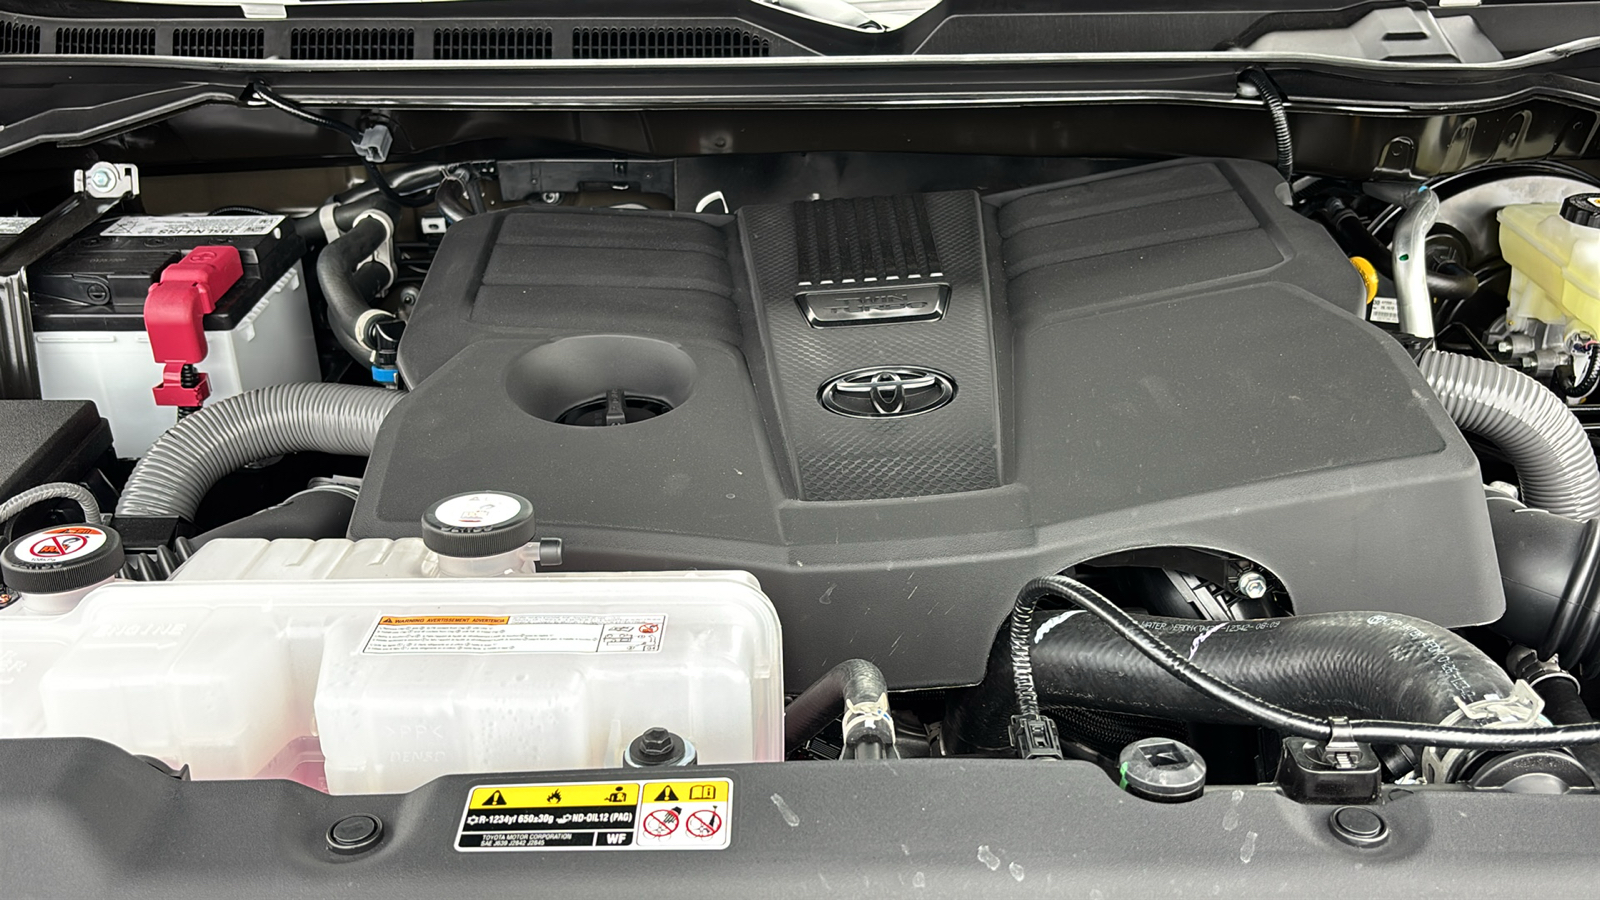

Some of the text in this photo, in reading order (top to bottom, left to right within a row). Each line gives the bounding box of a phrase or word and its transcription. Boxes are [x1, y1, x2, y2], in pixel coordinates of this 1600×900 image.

[390, 751, 446, 762] DENSO
[610, 812, 633, 823] (PAG)
[606, 833, 627, 844] WF
